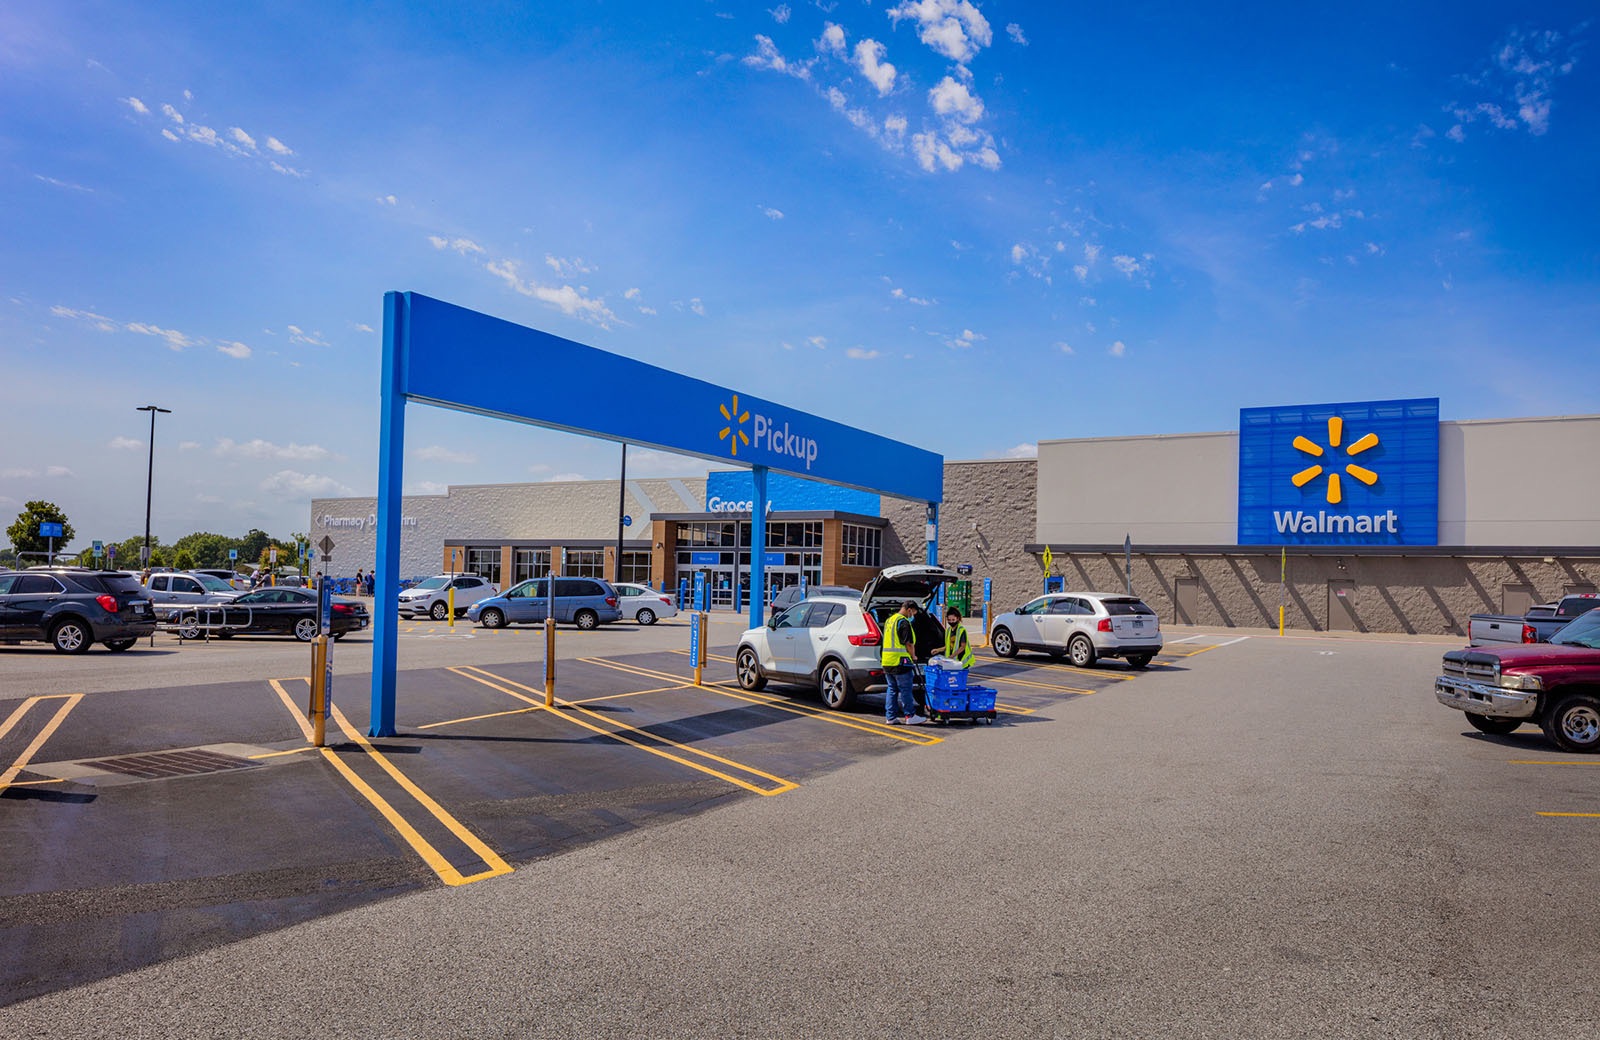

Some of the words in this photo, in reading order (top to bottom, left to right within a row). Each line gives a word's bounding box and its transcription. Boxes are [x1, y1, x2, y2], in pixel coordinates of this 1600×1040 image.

[753, 414, 818, 470] Pickup
[708, 496, 773, 517] Grocey
[324, 514, 365, 529] Pharmacy
[1273, 509, 1398, 533] Walmart
